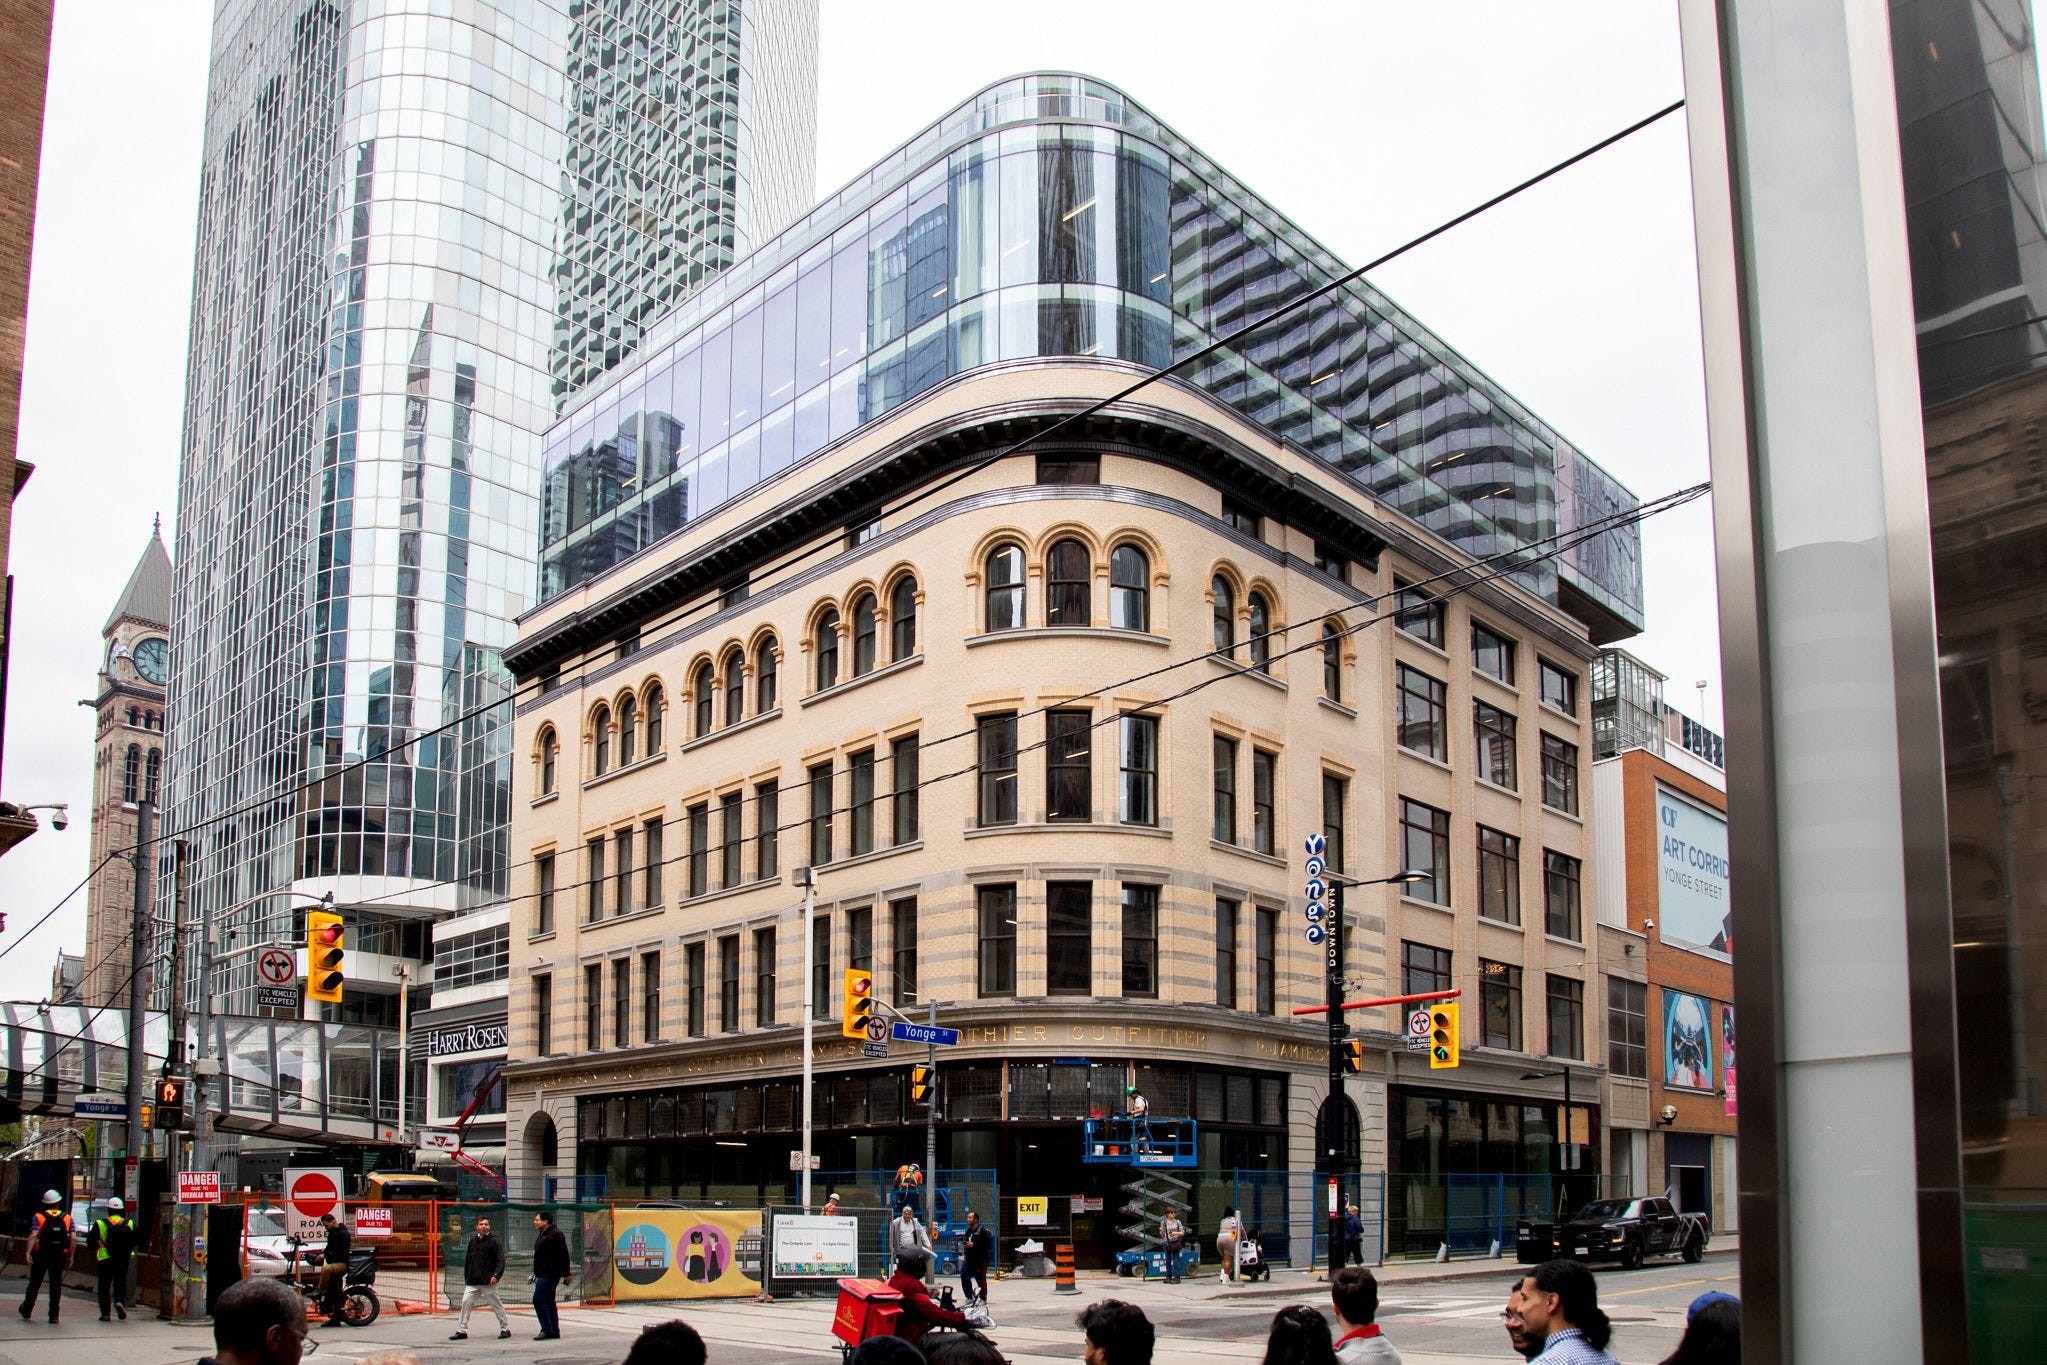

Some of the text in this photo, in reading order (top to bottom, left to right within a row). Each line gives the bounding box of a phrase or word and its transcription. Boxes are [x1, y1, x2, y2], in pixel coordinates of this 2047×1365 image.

[1661, 805, 1678, 828] CF
[1663, 834, 1729, 880] ART CORRID
[1664, 866, 1722, 900] YONGE STREET
[1305, 834, 1323, 945] Yonge
[1328, 888, 1336, 967] DOWNTOWN
[258, 988, 297, 999] TTC VEHICLES
[260, 996, 295, 1006] EXCEPTED
[905, 1025, 949, 1042] Yonge St
[957, 1025, 1207, 1046] THIER OUTFITTER
[427, 1025, 508, 1056] HARRY ROSEN
[865, 1049, 887, 1057] EXCEPTED
[85, 1103, 110, 1113] Yonge
[181, 1173, 218, 1186] DANGER
[181, 1191, 218, 1199] OVERHEAD WIRES
[1019, 1203, 1041, 1212] EXIT
[357, 1209, 391, 1220] DANGER
[300, 1220, 322, 1228] ROA
[294, 1231, 329, 1239] CLOSE
